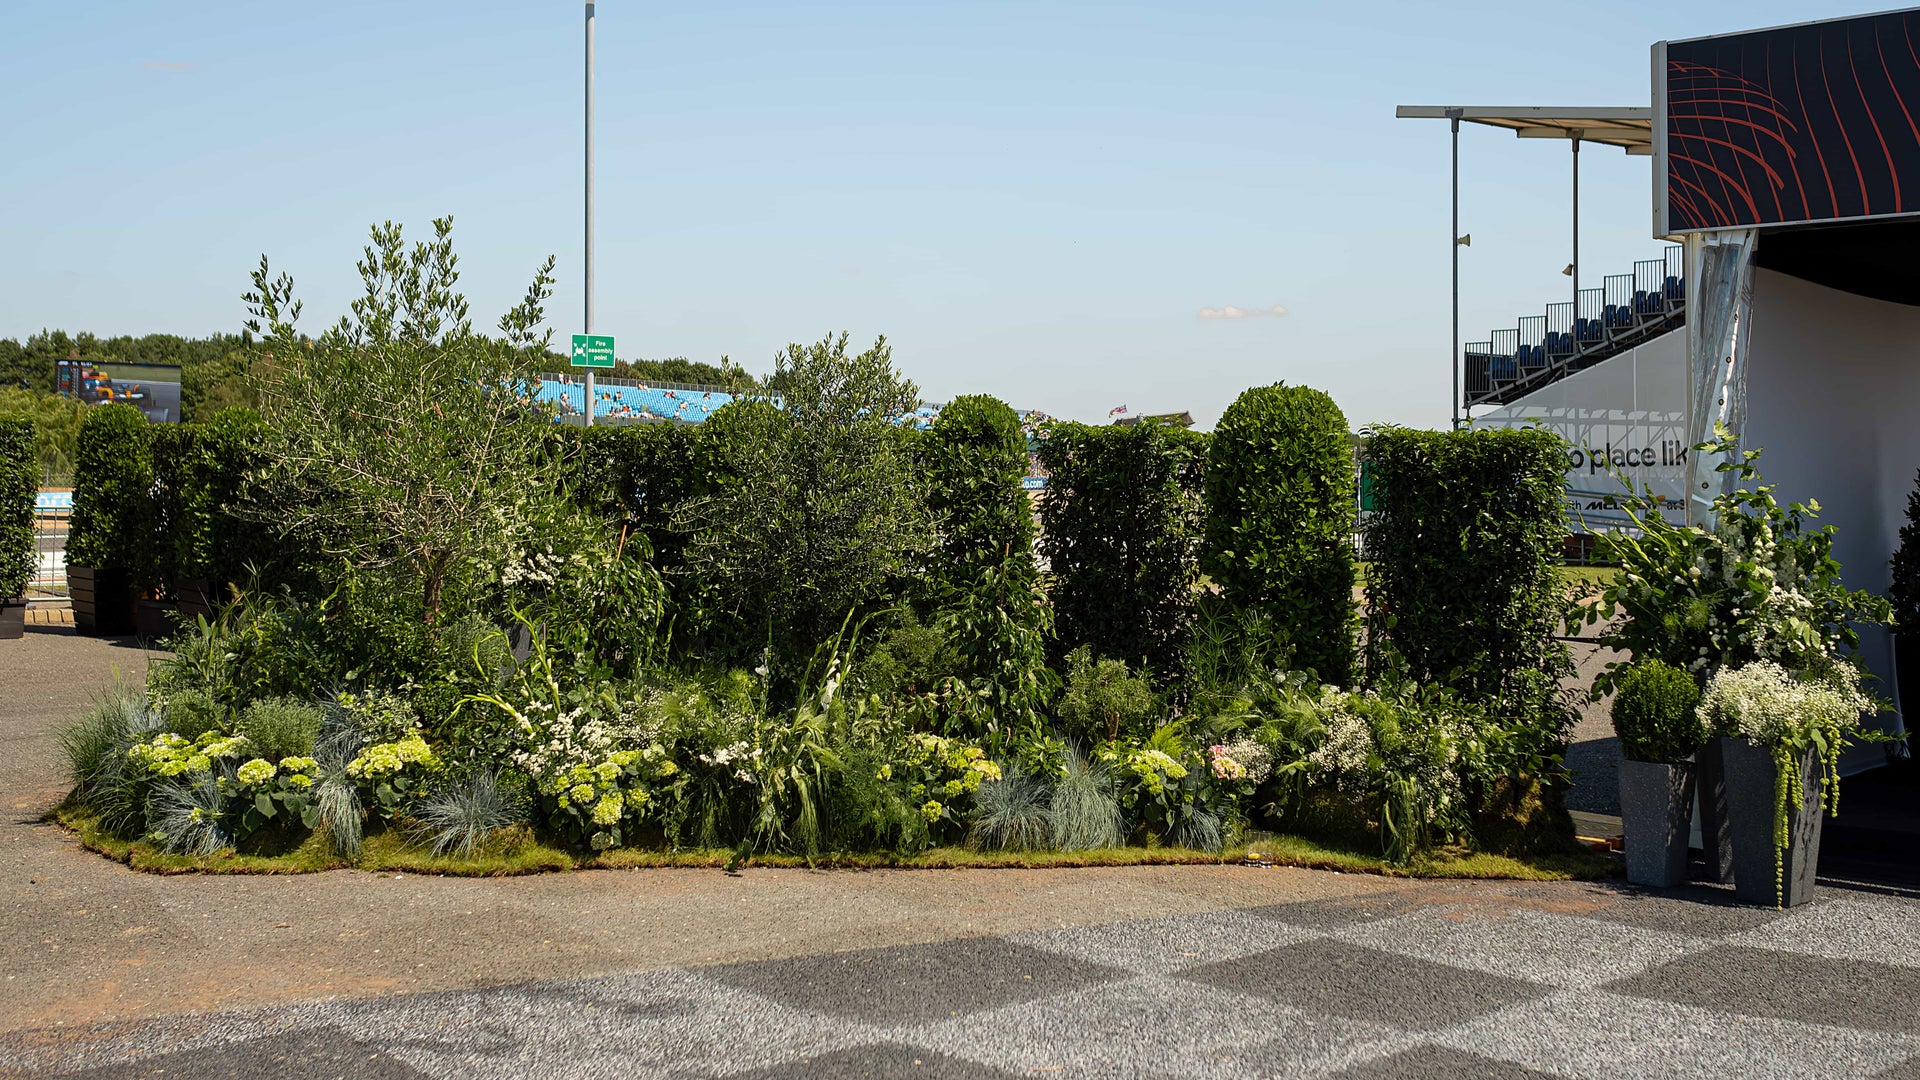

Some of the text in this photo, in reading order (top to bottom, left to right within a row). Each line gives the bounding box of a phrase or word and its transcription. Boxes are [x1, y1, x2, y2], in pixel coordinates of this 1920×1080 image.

[588, 347, 613, 355] assembly
[1565, 449, 1585, 469] o
[1592, 443, 1656, 475] place
